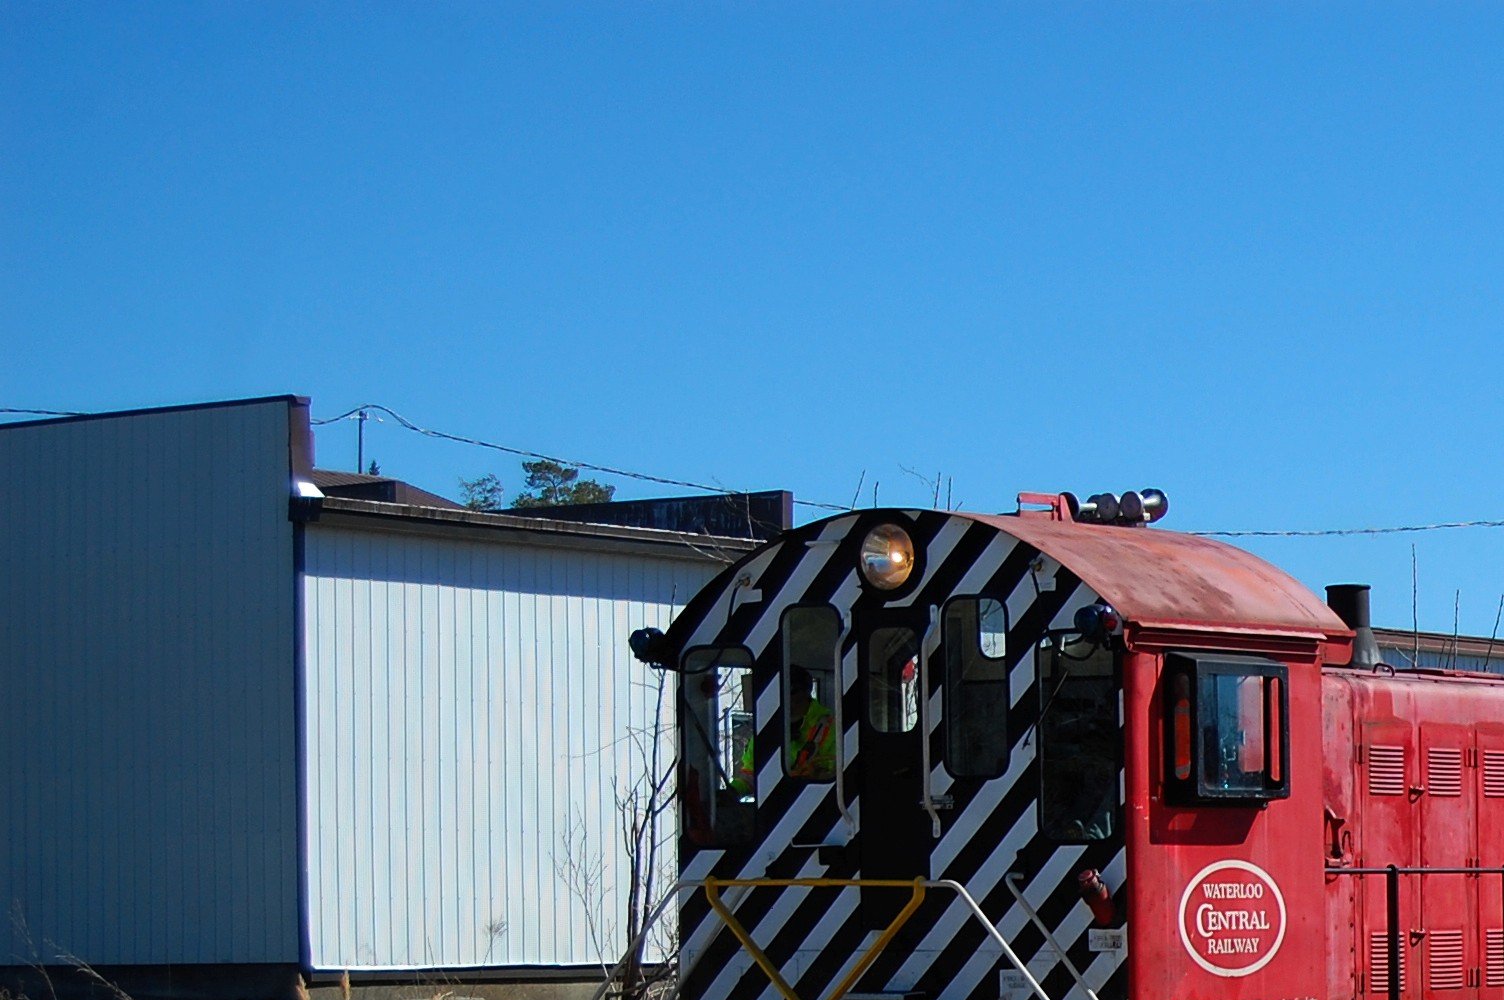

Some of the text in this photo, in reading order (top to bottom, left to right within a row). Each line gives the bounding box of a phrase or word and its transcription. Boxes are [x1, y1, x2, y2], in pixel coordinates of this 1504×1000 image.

[1203, 883, 1263, 899] WATERLOO
[1196, 903, 1270, 937] CENTRAL
[1208, 938, 1260, 954] RAILWAY
